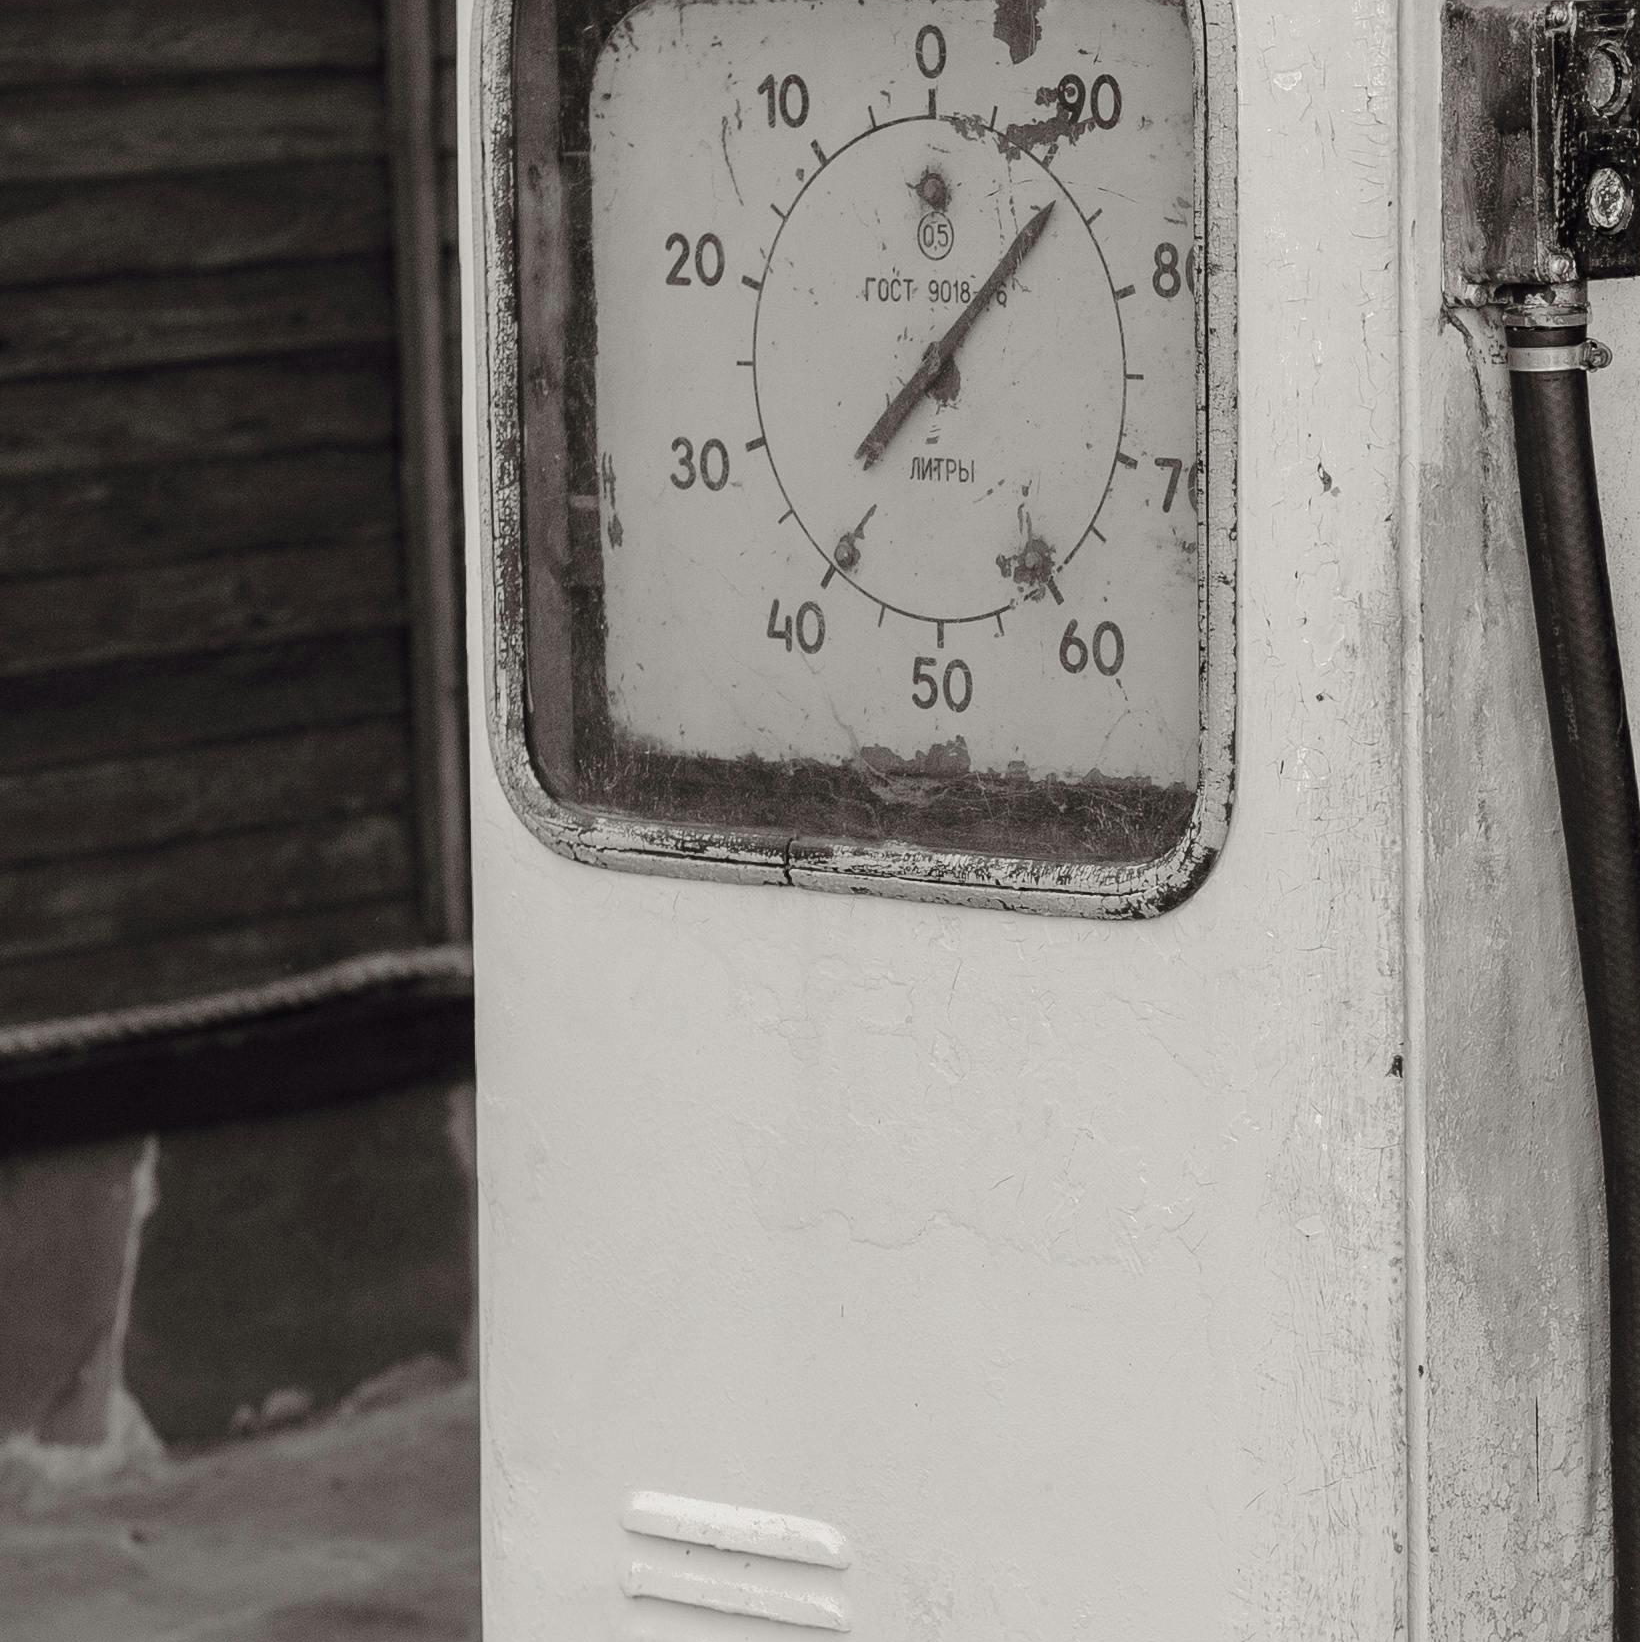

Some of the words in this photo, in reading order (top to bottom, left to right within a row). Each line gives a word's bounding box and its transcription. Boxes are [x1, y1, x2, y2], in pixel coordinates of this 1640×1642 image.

[915, 24, 947, 79] 0
[757, 73, 810, 129] 10
[1057, 73, 1122, 131] 90
[664, 231, 726, 287] 20
[864, 276, 914, 302] ГОСТ
[669, 436, 730, 492] 30
[909, 456, 976, 484] ЛИТРЫ
[765, 598, 826, 655] 40
[1058, 619, 1125, 677] 60
[911, 657, 974, 713] 50
